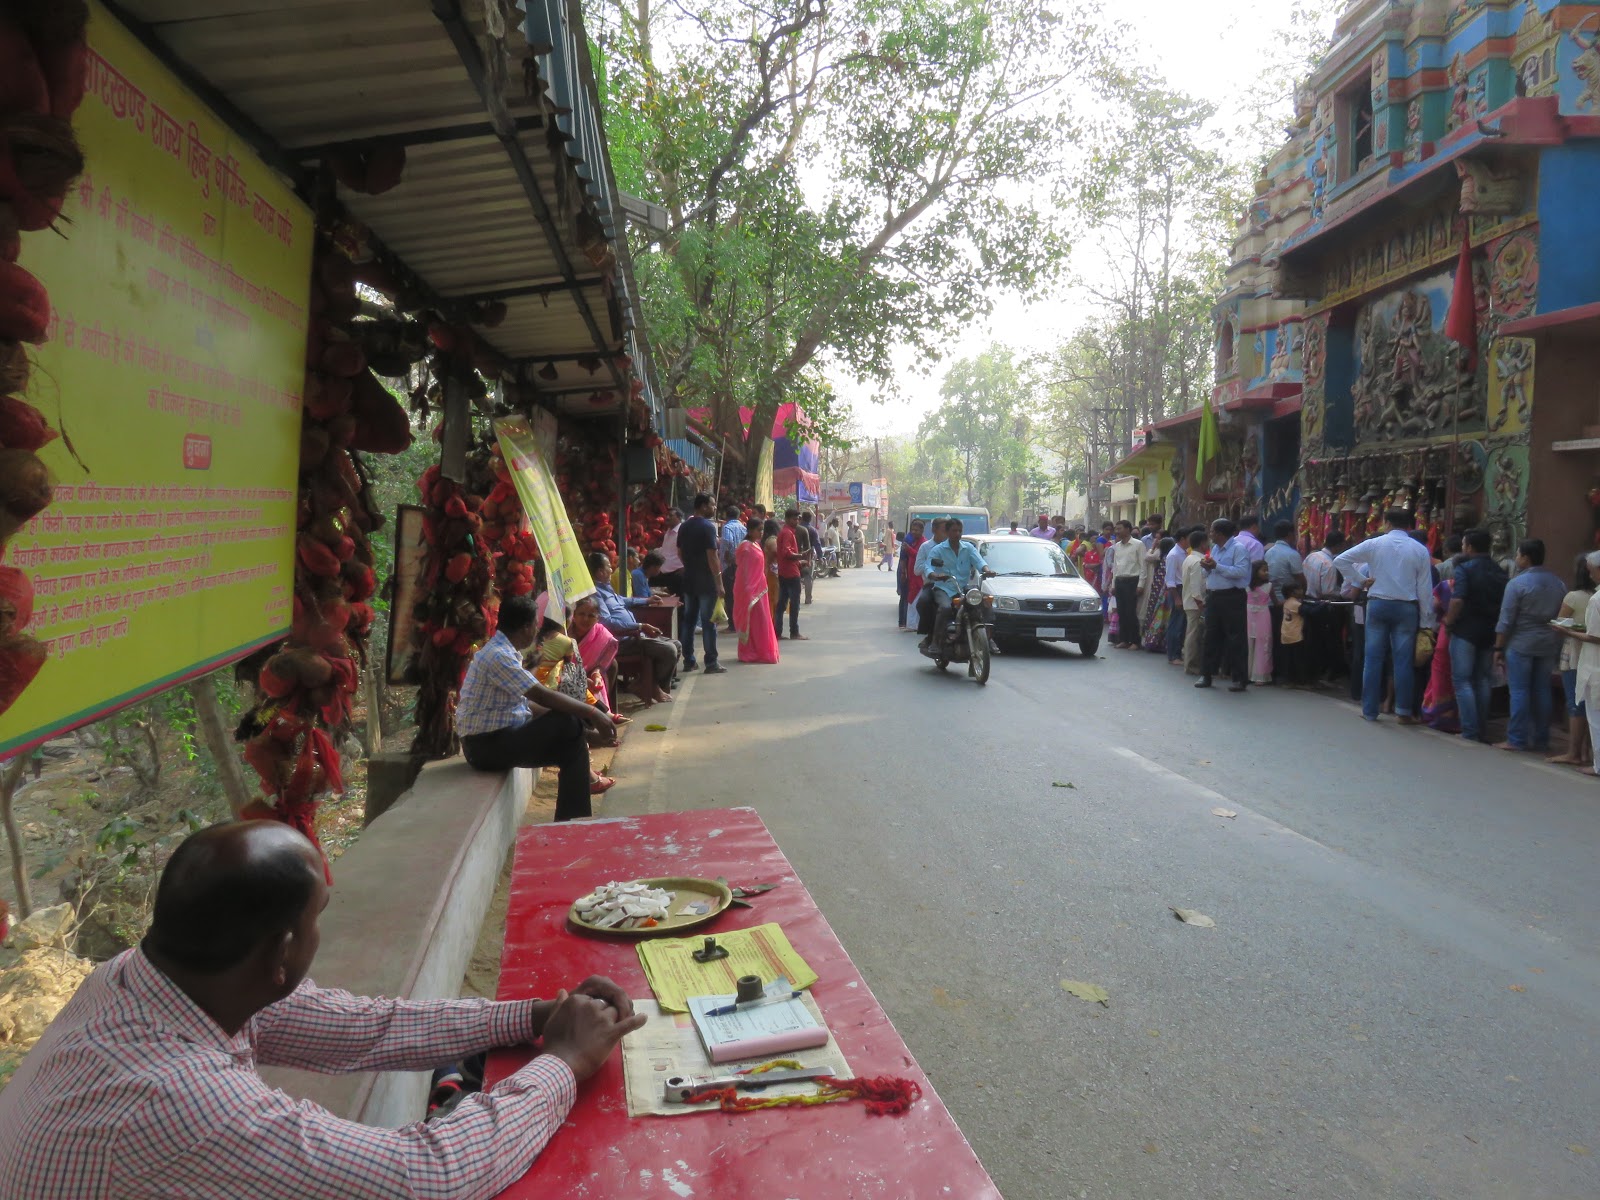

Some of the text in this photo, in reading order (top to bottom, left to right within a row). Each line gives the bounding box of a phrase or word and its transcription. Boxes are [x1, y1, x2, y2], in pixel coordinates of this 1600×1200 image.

[151, 103, 184, 159] राज्य
[42, 510, 63, 534] किसी
[84, 516, 94, 530] का
[83, 540, 101, 558] केवल
[34, 574, 58, 595] विवाह
[60, 575, 82, 592] प्रमाण
[62, 599, 84, 621] अपील
